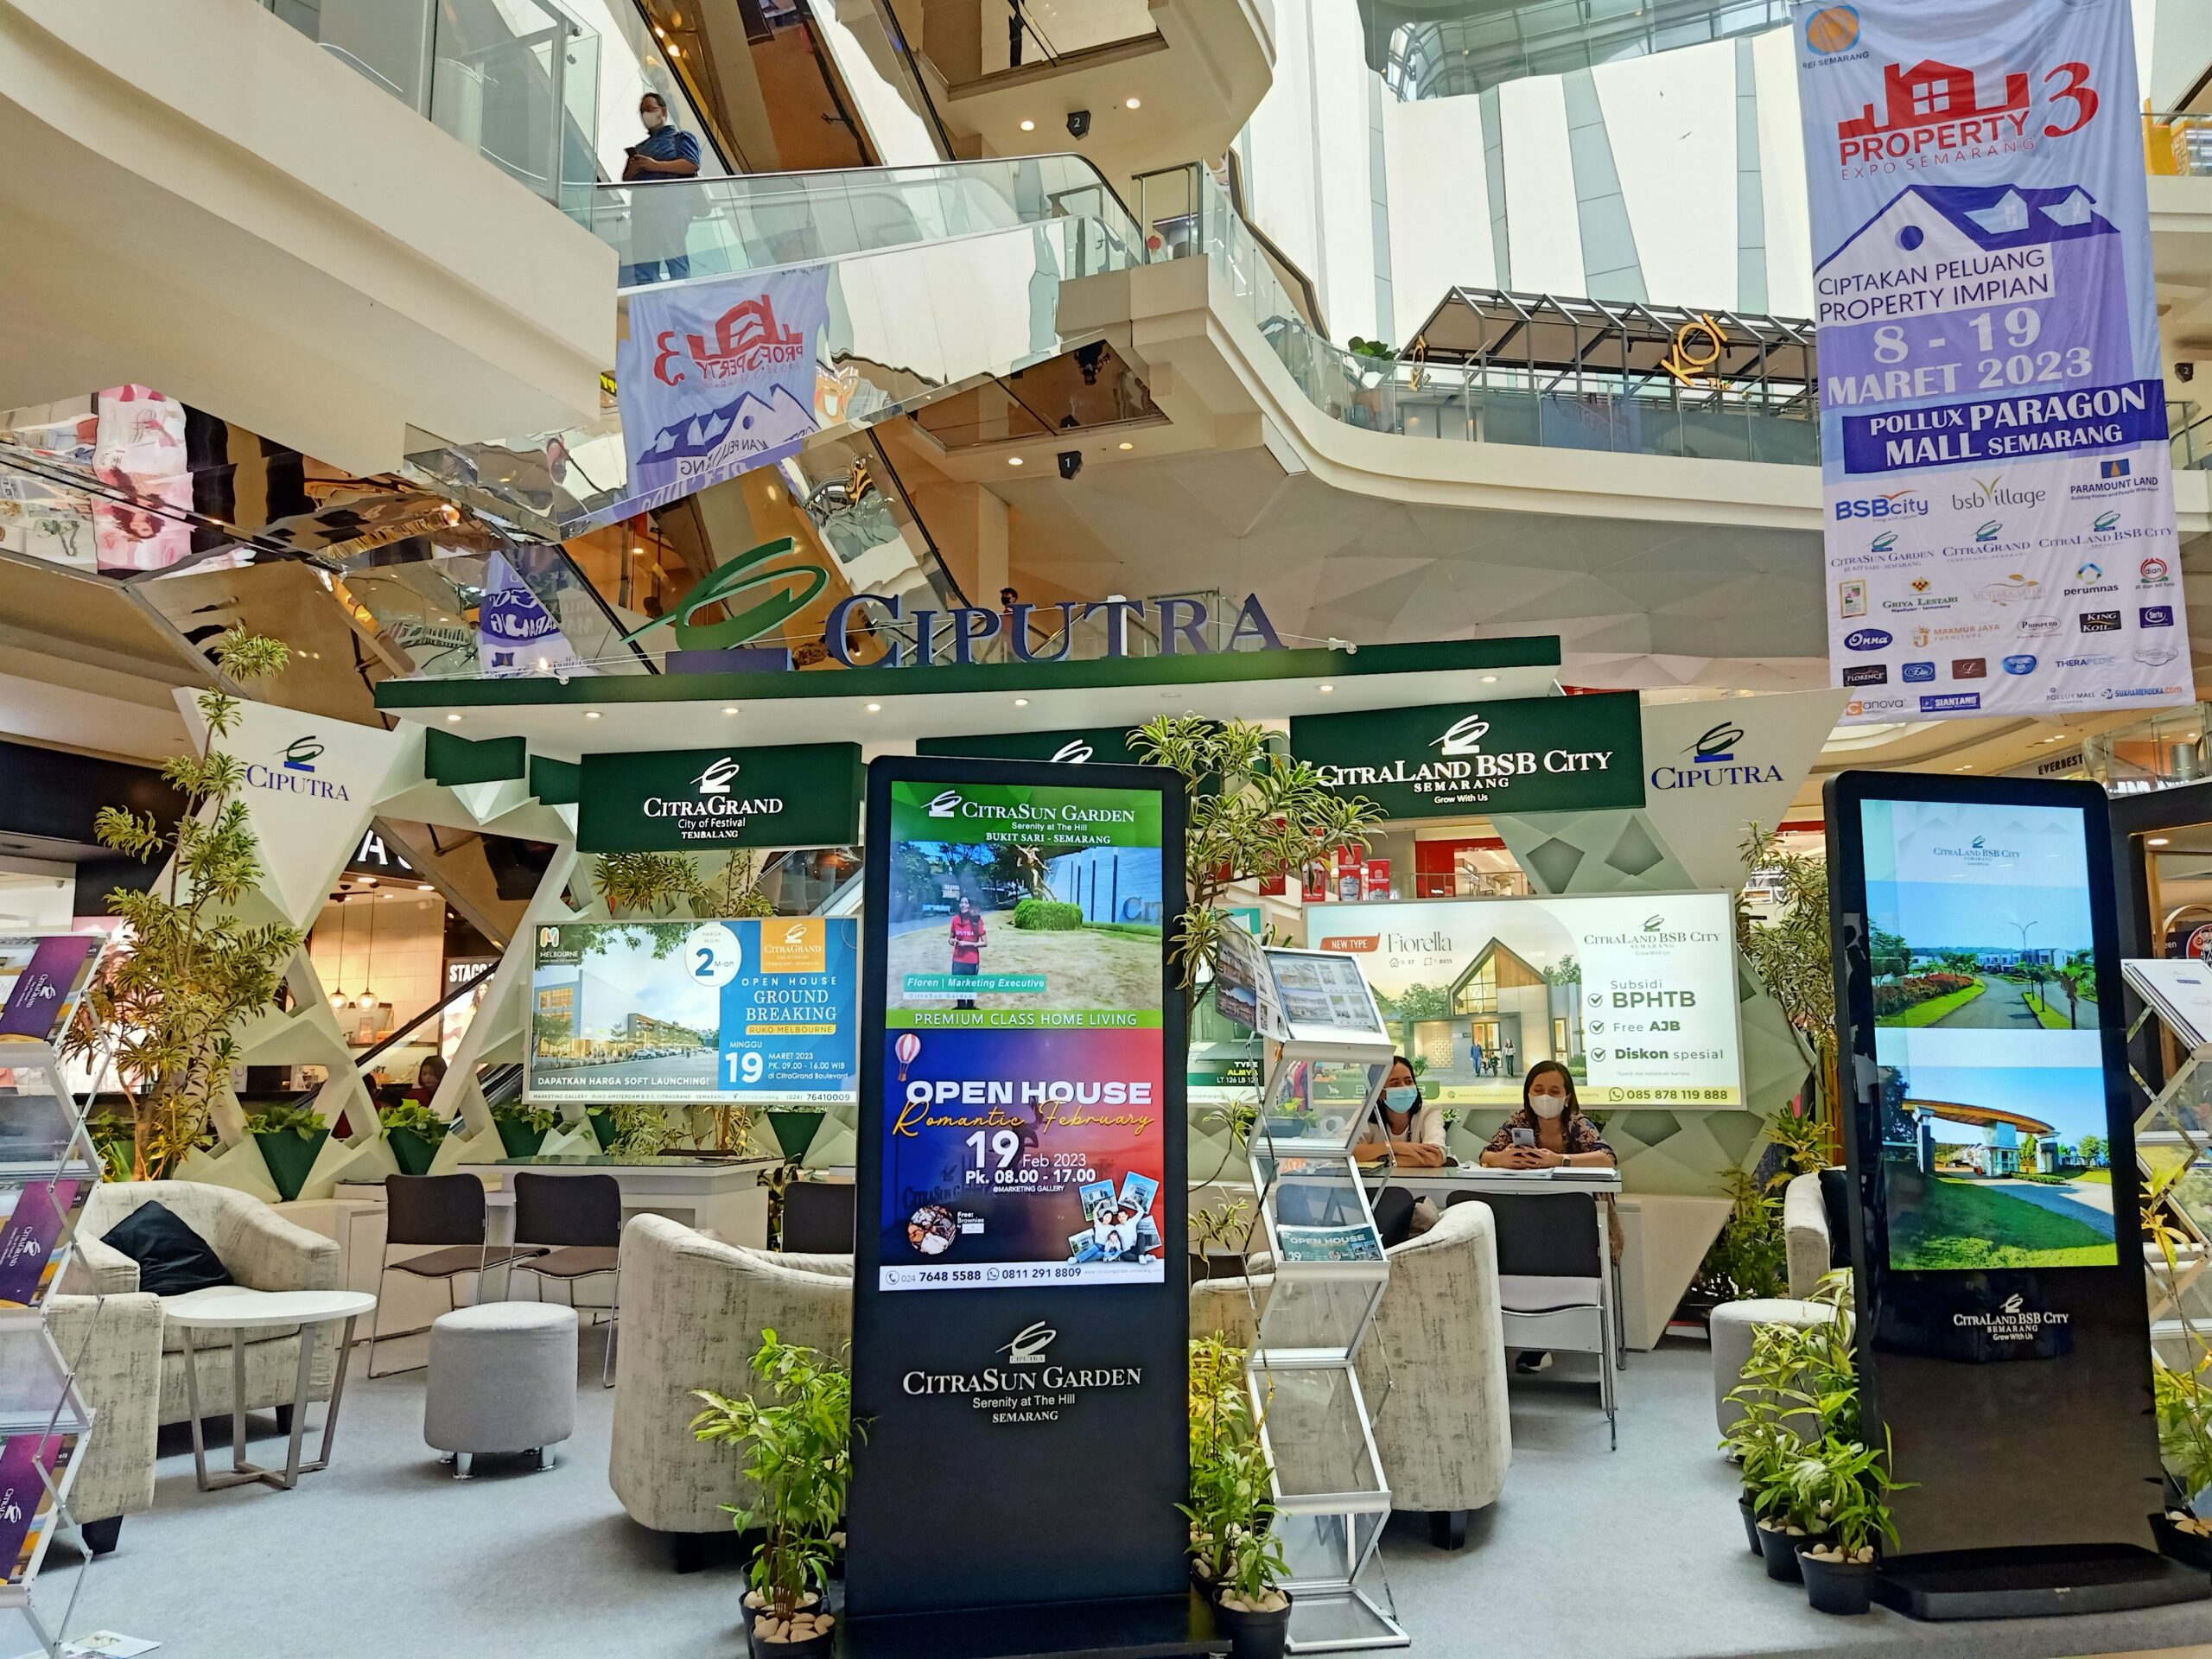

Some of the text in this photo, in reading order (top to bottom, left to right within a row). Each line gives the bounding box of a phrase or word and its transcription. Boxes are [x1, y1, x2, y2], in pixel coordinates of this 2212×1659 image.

[1818, 51, 1870, 67] SEMARANG
[2044, 62, 2100, 138] 3
[1073, 117, 1081, 128] 2
[1840, 111, 2030, 166] PROPERTY
[1841, 137, 2036, 181] EXPO SEMARANG
[1819, 249, 2045, 296] CIPTAKAN PELUANG
[1820, 274, 2049, 321] PROPERTY IMPIAN
[1873, 307, 2041, 364] 8 19
[1828, 347, 2093, 405] MARET 2023
[1870, 384, 2146, 435] POLLUX PARAGON
[1885, 423, 2123, 467] MALL SEMARANG
[2070, 477, 2158, 493] PARAMOUNT LAND
[1836, 498, 1929, 520] BSBcity
[2114, 528, 2142, 541] BSB
[2064, 584, 2119, 597] perumnas
[2087, 612, 2118, 620] KING
[1934, 624, 2000, 635] MAKMUR JAYA
[1477, 753, 1537, 779] BSB
[2037, 753, 2083, 776] EVERBEST
[1414, 778, 1510, 794] SEMARANG
[1433, 793, 1489, 805] Grow With Us
[677, 817, 747, 830] City of Festival
[1011, 822, 1087, 832] Serenity at The Hill
[681, 830, 739, 840] TEMBALANG
[986, 832, 1111, 844] BUKIT SARI SEMARANG
[1982, 849, 1999, 858] BSB
[1332, 938, 1368, 949] NEW TYPE
[1388, 931, 1452, 953] Fiorella
[1660, 932, 1687, 943] BSB
[695, 947, 734, 977] 2 M-an
[741, 976, 837, 987] OPEN HOUSE
[907, 977, 1045, 989] Floren Marketing Executive
[1611, 979, 1662, 989] Subsidi
[753, 989, 829, 1004] GROUND
[1612, 991, 1696, 1008] BPHTB
[746, 1006, 837, 1021] BREAKING
[914, 1014, 1137, 1026] PREMIUM CLASS HOME LIVING
[1613, 1020, 1681, 1032] Free AJB
[796, 1052, 814, 1060] 2023
[1615, 1047, 1724, 1061] Diskon spesial
[725, 1052, 764, 1084] 19
[537, 1077, 709, 1085] DAPATKAN HARGA SOFT LAUNCHING!
[807, 1093, 850, 1102] 76410009
[906, 1080, 1153, 1105] OPEN HOUSE
[1627, 1090, 1728, 1100] 085 878 119 888
[893, 1099, 1155, 1137] Romantic February
[965, 1130, 1086, 1169] 19 Feb 2023
[965, 1169, 1096, 1185] Pk. 08.00 17.00
[1325, 1234, 1366, 1244] HOUSE
[901, 1274, 916, 1282] 024
[918, 1271, 949, 1282] 7648
[952, 1270, 982, 1281] 5588
[1001, 1268, 1028, 1280] 0811
[1032, 1268, 1052, 1279] 291
[1055, 1267, 1082, 1278] 8809
[2018, 1313, 2041, 1324] BSB
[972, 1393, 1076, 1410] Serenity at The Hill
[992, 1411, 1058, 1423] SEMARANG
